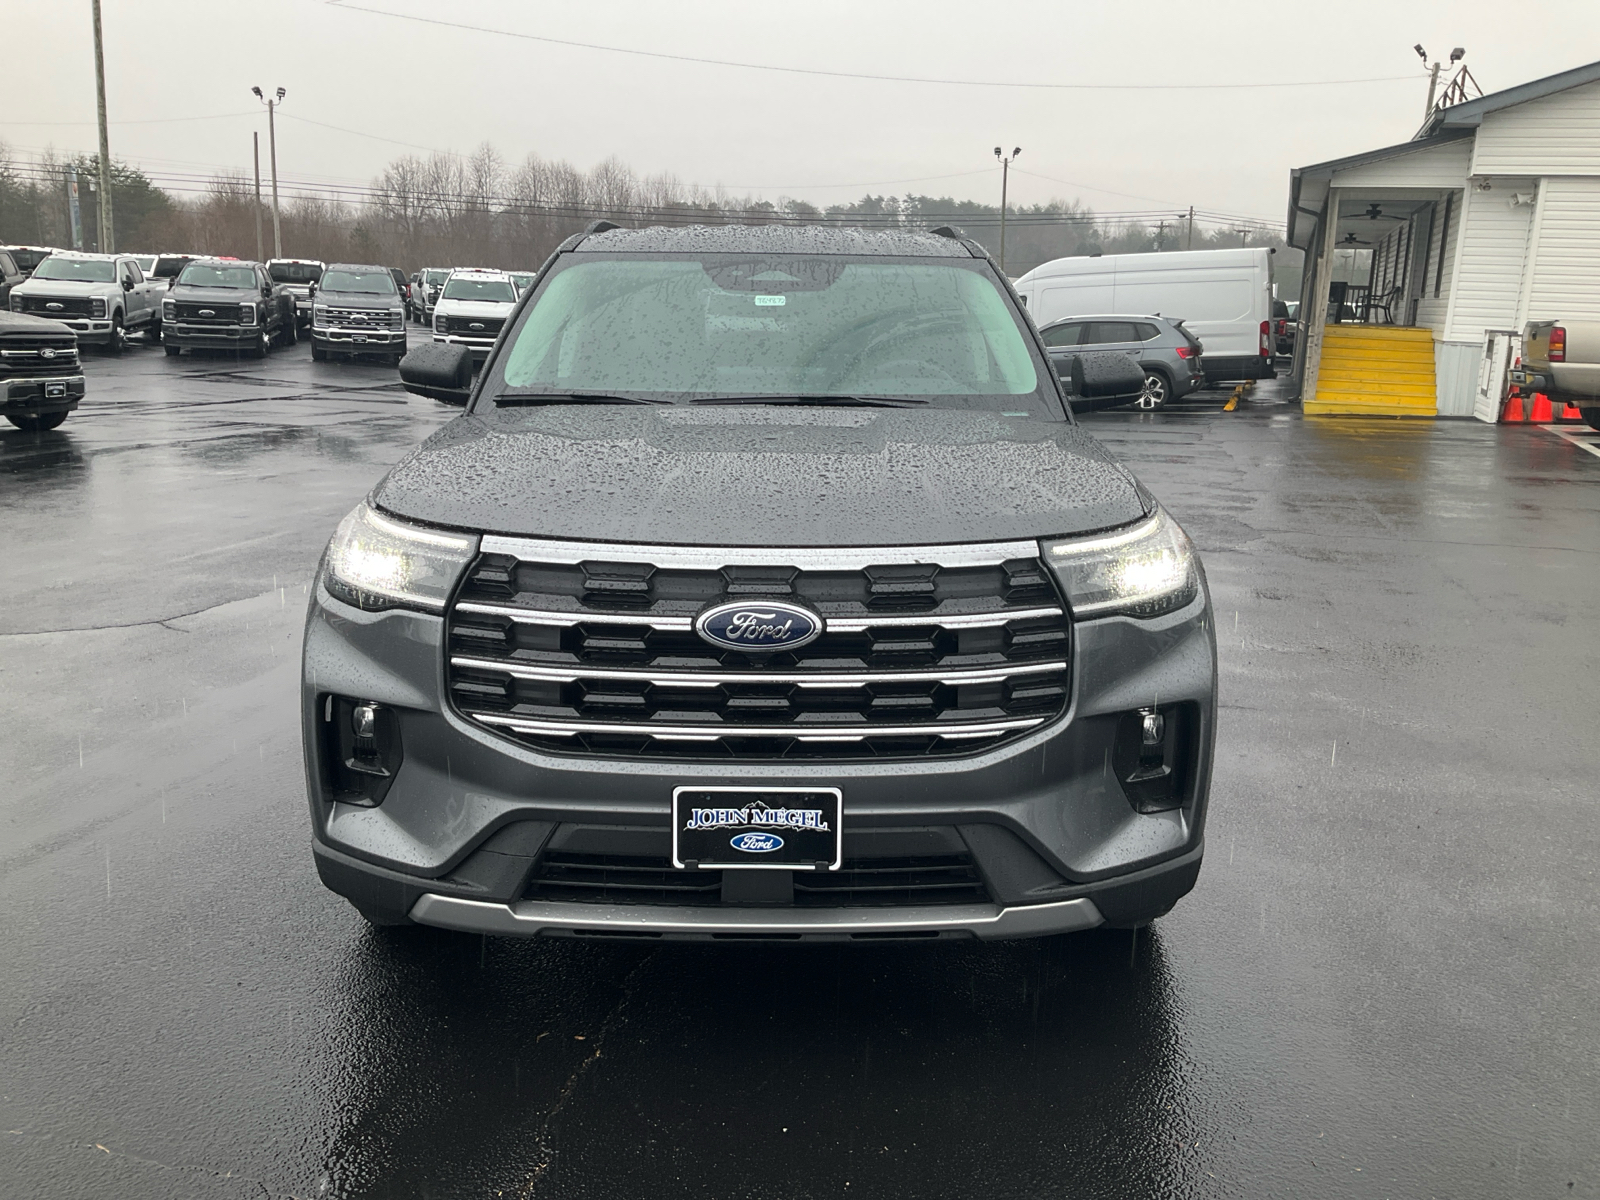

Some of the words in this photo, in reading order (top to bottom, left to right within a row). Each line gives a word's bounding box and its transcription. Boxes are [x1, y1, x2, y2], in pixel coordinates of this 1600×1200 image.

[726, 611, 793, 640] Ford
[688, 808, 749, 829] JOHN
[751, 808, 828, 830] MEGEL
[740, 835, 773, 850] Ford
